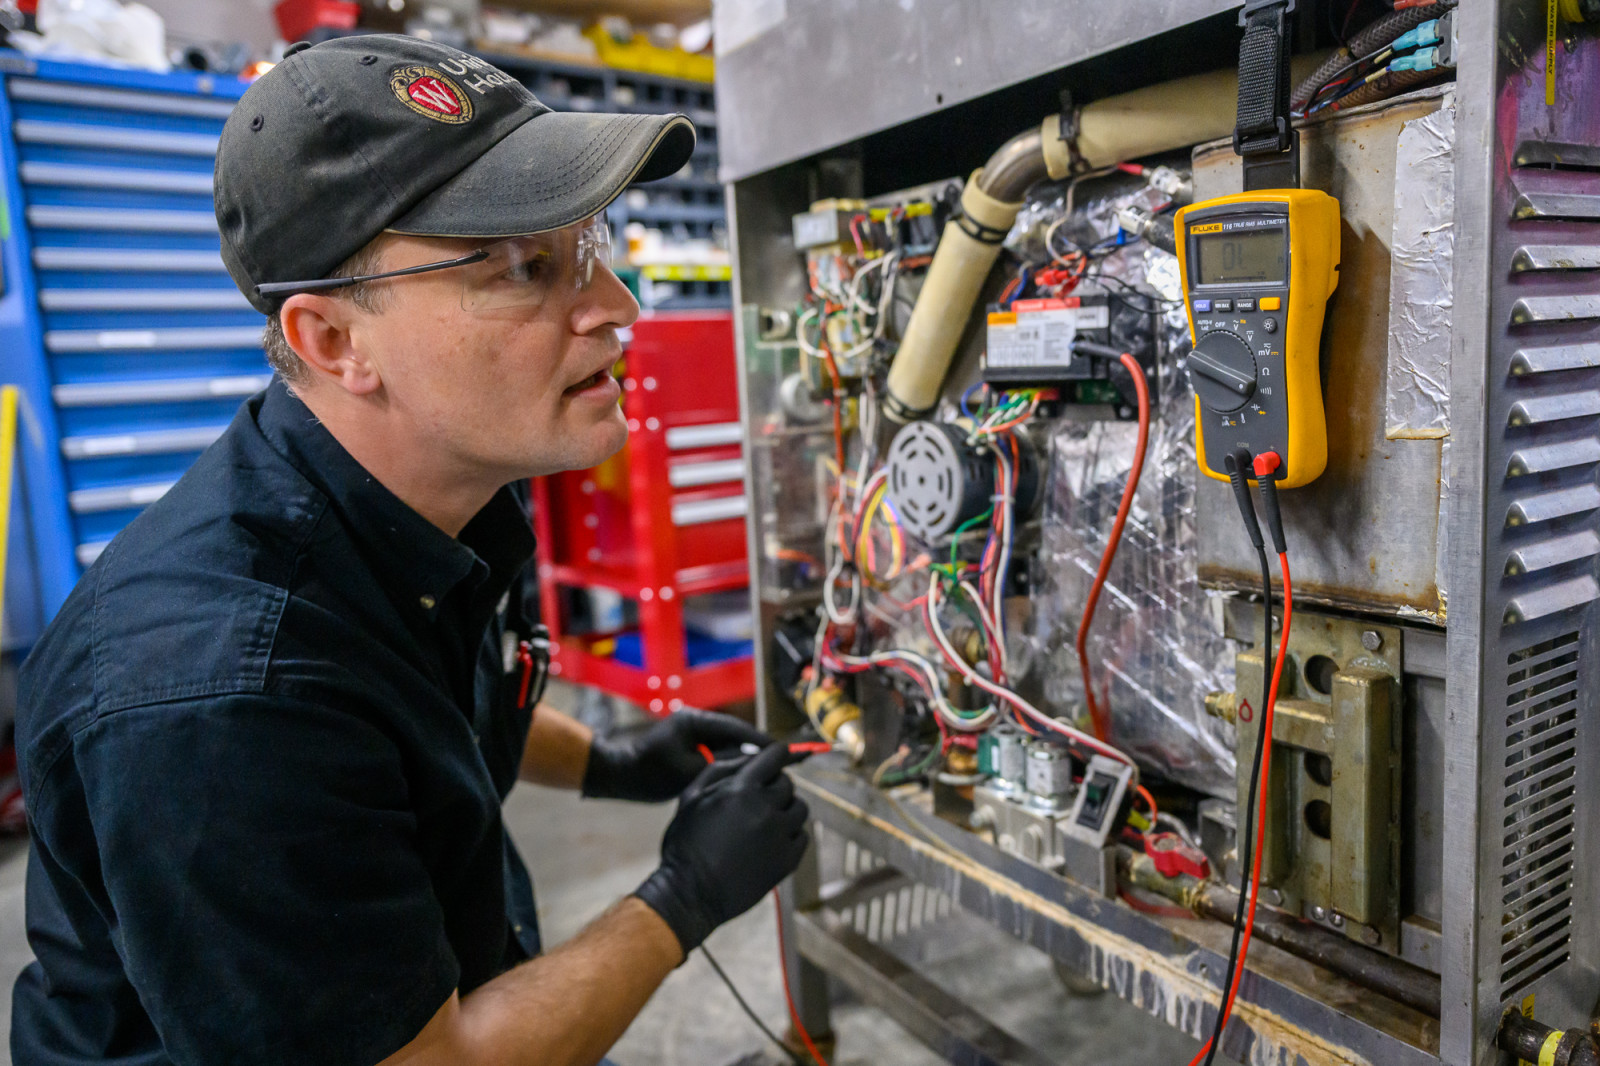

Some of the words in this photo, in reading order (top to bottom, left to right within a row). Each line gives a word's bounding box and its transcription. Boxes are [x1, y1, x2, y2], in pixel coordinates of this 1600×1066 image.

[411, 79, 459, 113] W
[1192, 224, 1220, 233] FLUKE
[1256, 218, 1287, 226] MULTIMETER
